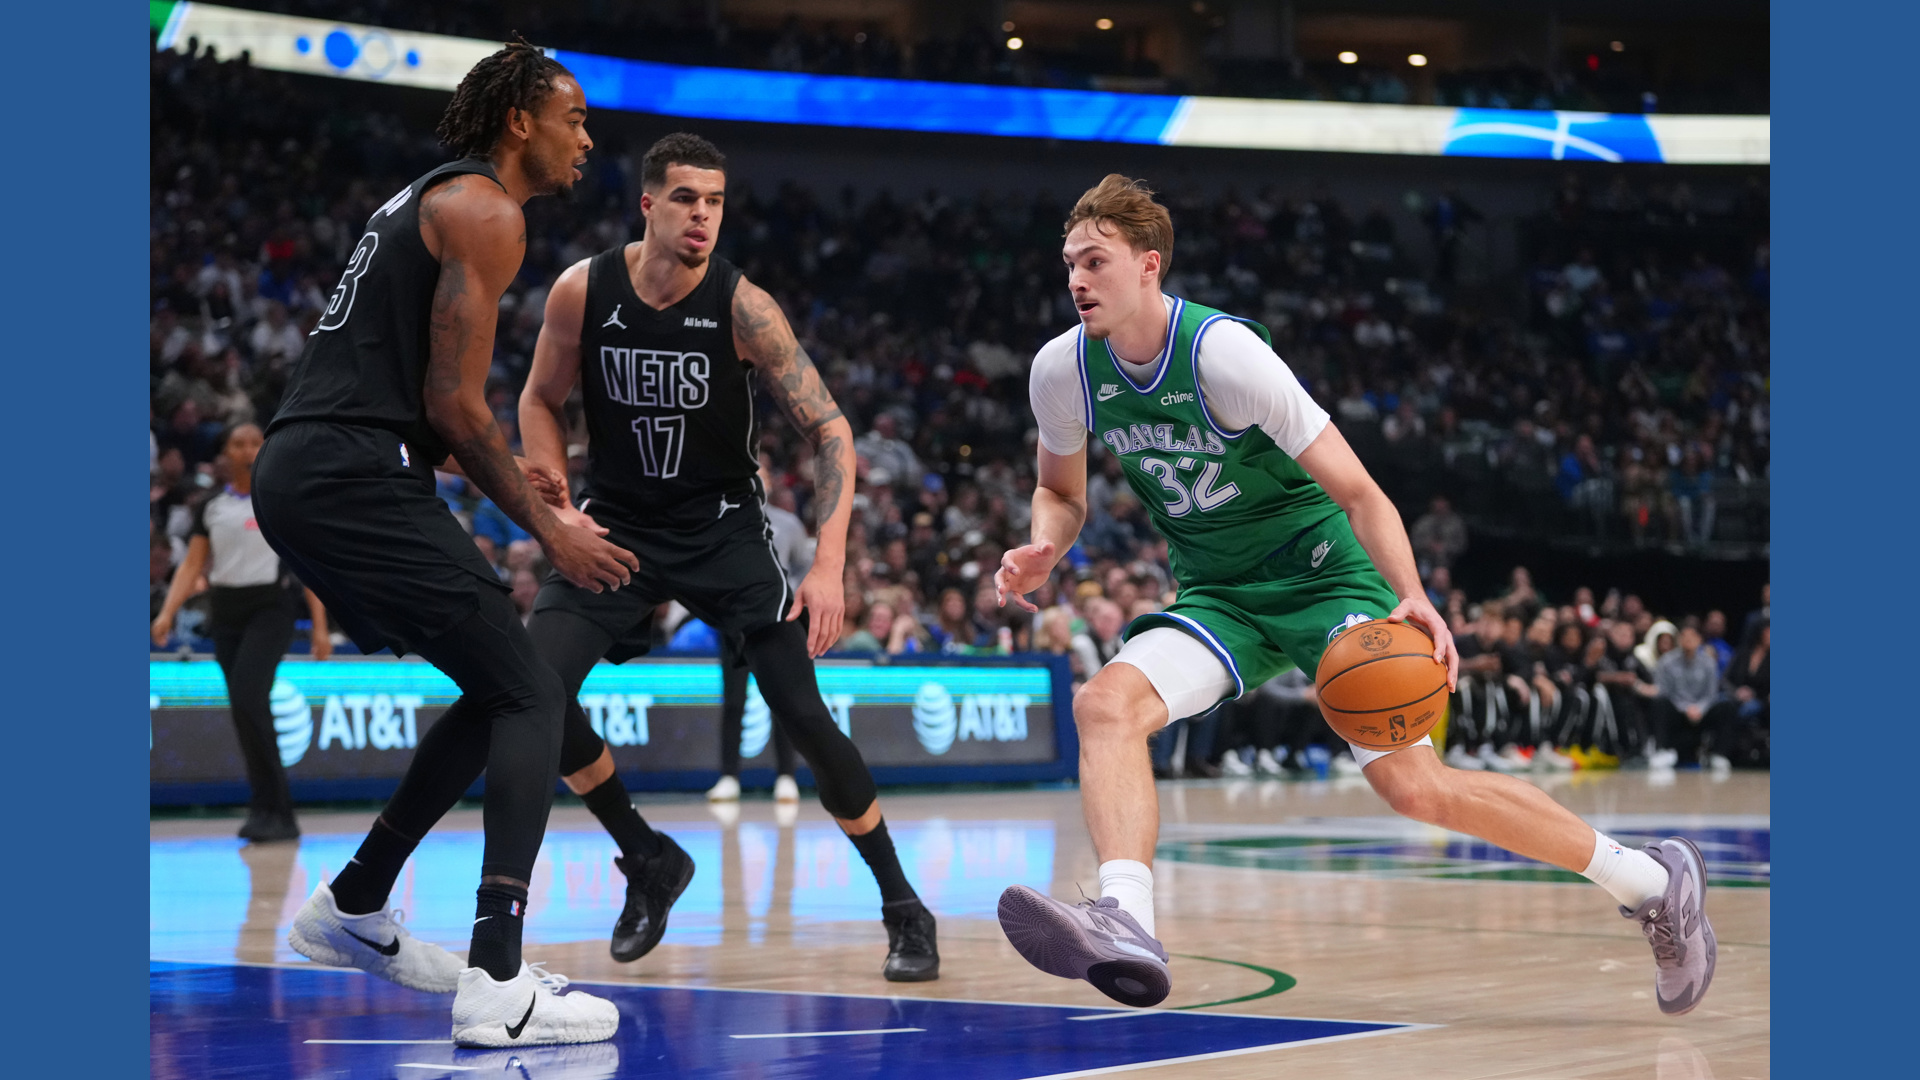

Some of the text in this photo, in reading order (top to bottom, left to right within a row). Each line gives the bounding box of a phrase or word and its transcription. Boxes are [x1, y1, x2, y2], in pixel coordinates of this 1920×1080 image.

[309, 231, 379, 336] 3
[683, 317, 718, 328] All In Won
[600, 346, 709, 409] NETS
[1100, 384, 1119, 395] NIKE
[1160, 391, 1194, 406] chime
[631, 414, 685, 479] 17
[1103, 423, 1226, 455] DALLAS
[1140, 456, 1242, 517] 32
[1311, 540, 1329, 561] NIKE
[317, 693, 424, 750] AT&T
[580, 693, 654, 747] T&T
[958, 693, 1031, 742] AT&T
